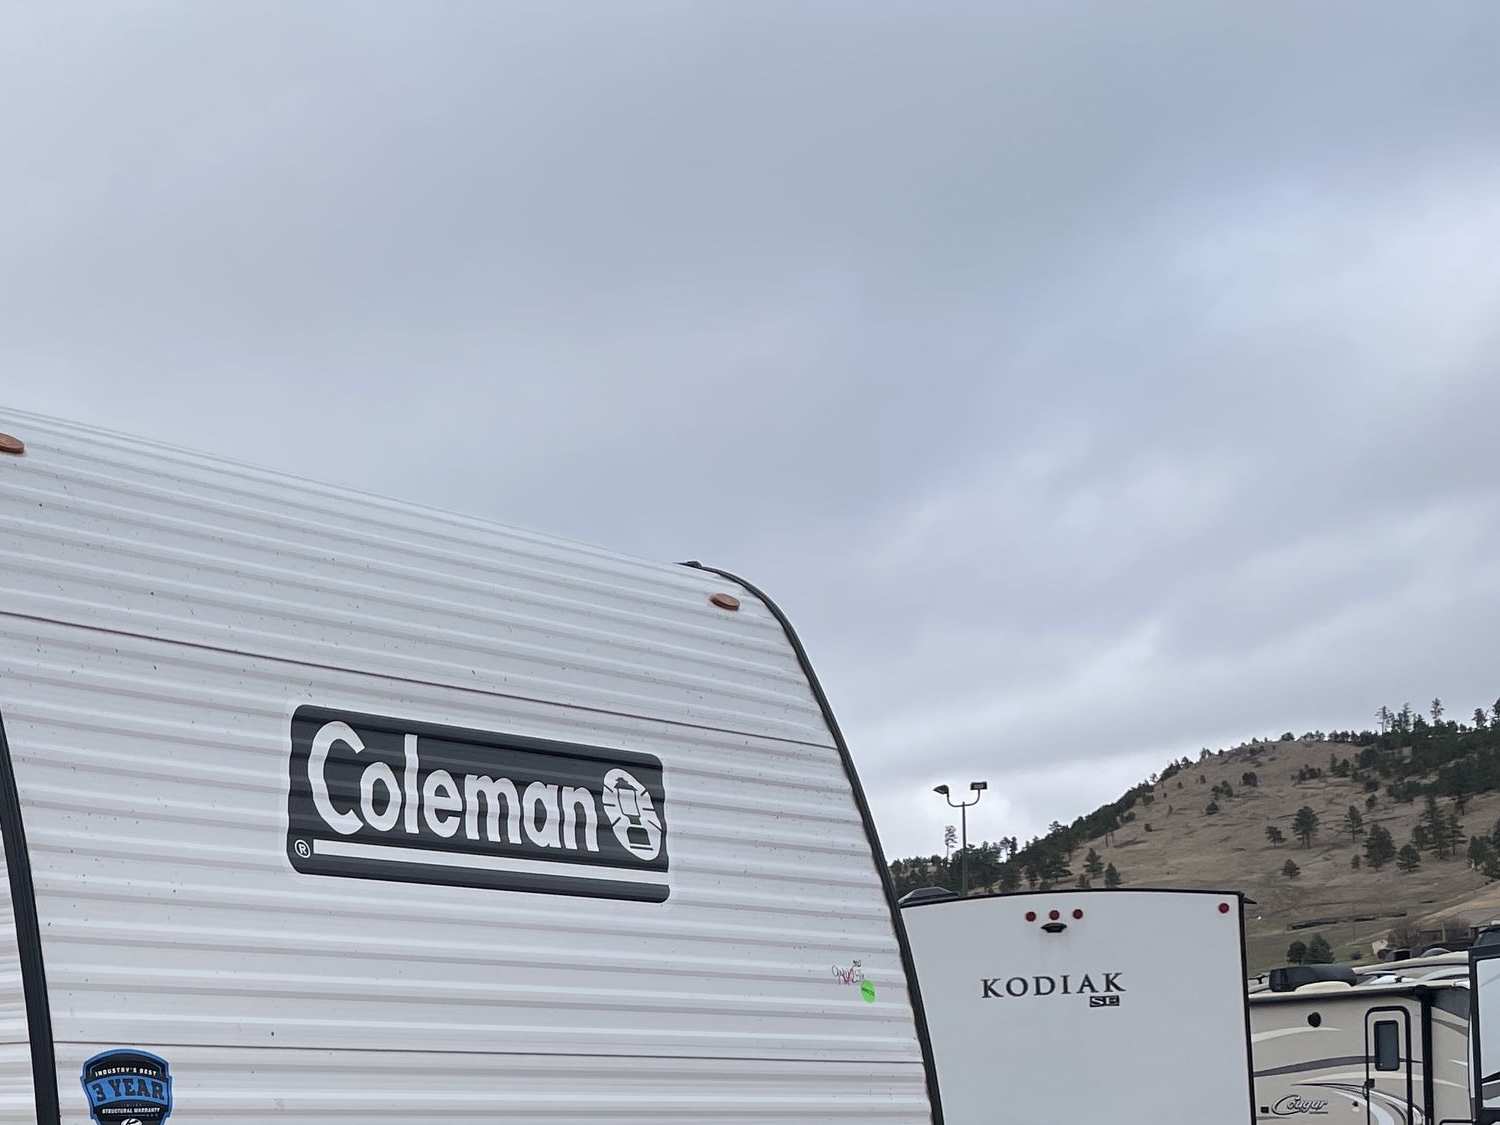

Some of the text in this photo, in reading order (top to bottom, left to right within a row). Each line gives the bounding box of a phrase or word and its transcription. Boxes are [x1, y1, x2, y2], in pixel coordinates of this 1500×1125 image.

[307, 720, 600, 853] Coleman
[980, 972, 1126, 998] KODIAK
[1090, 995, 1120, 1007] SE
[94, 1067, 157, 1077] INDUSTRY'S BEST
[92, 1078, 164, 1101] 3 YEAR
[1271, 1095, 1328, 1115] Cougar
